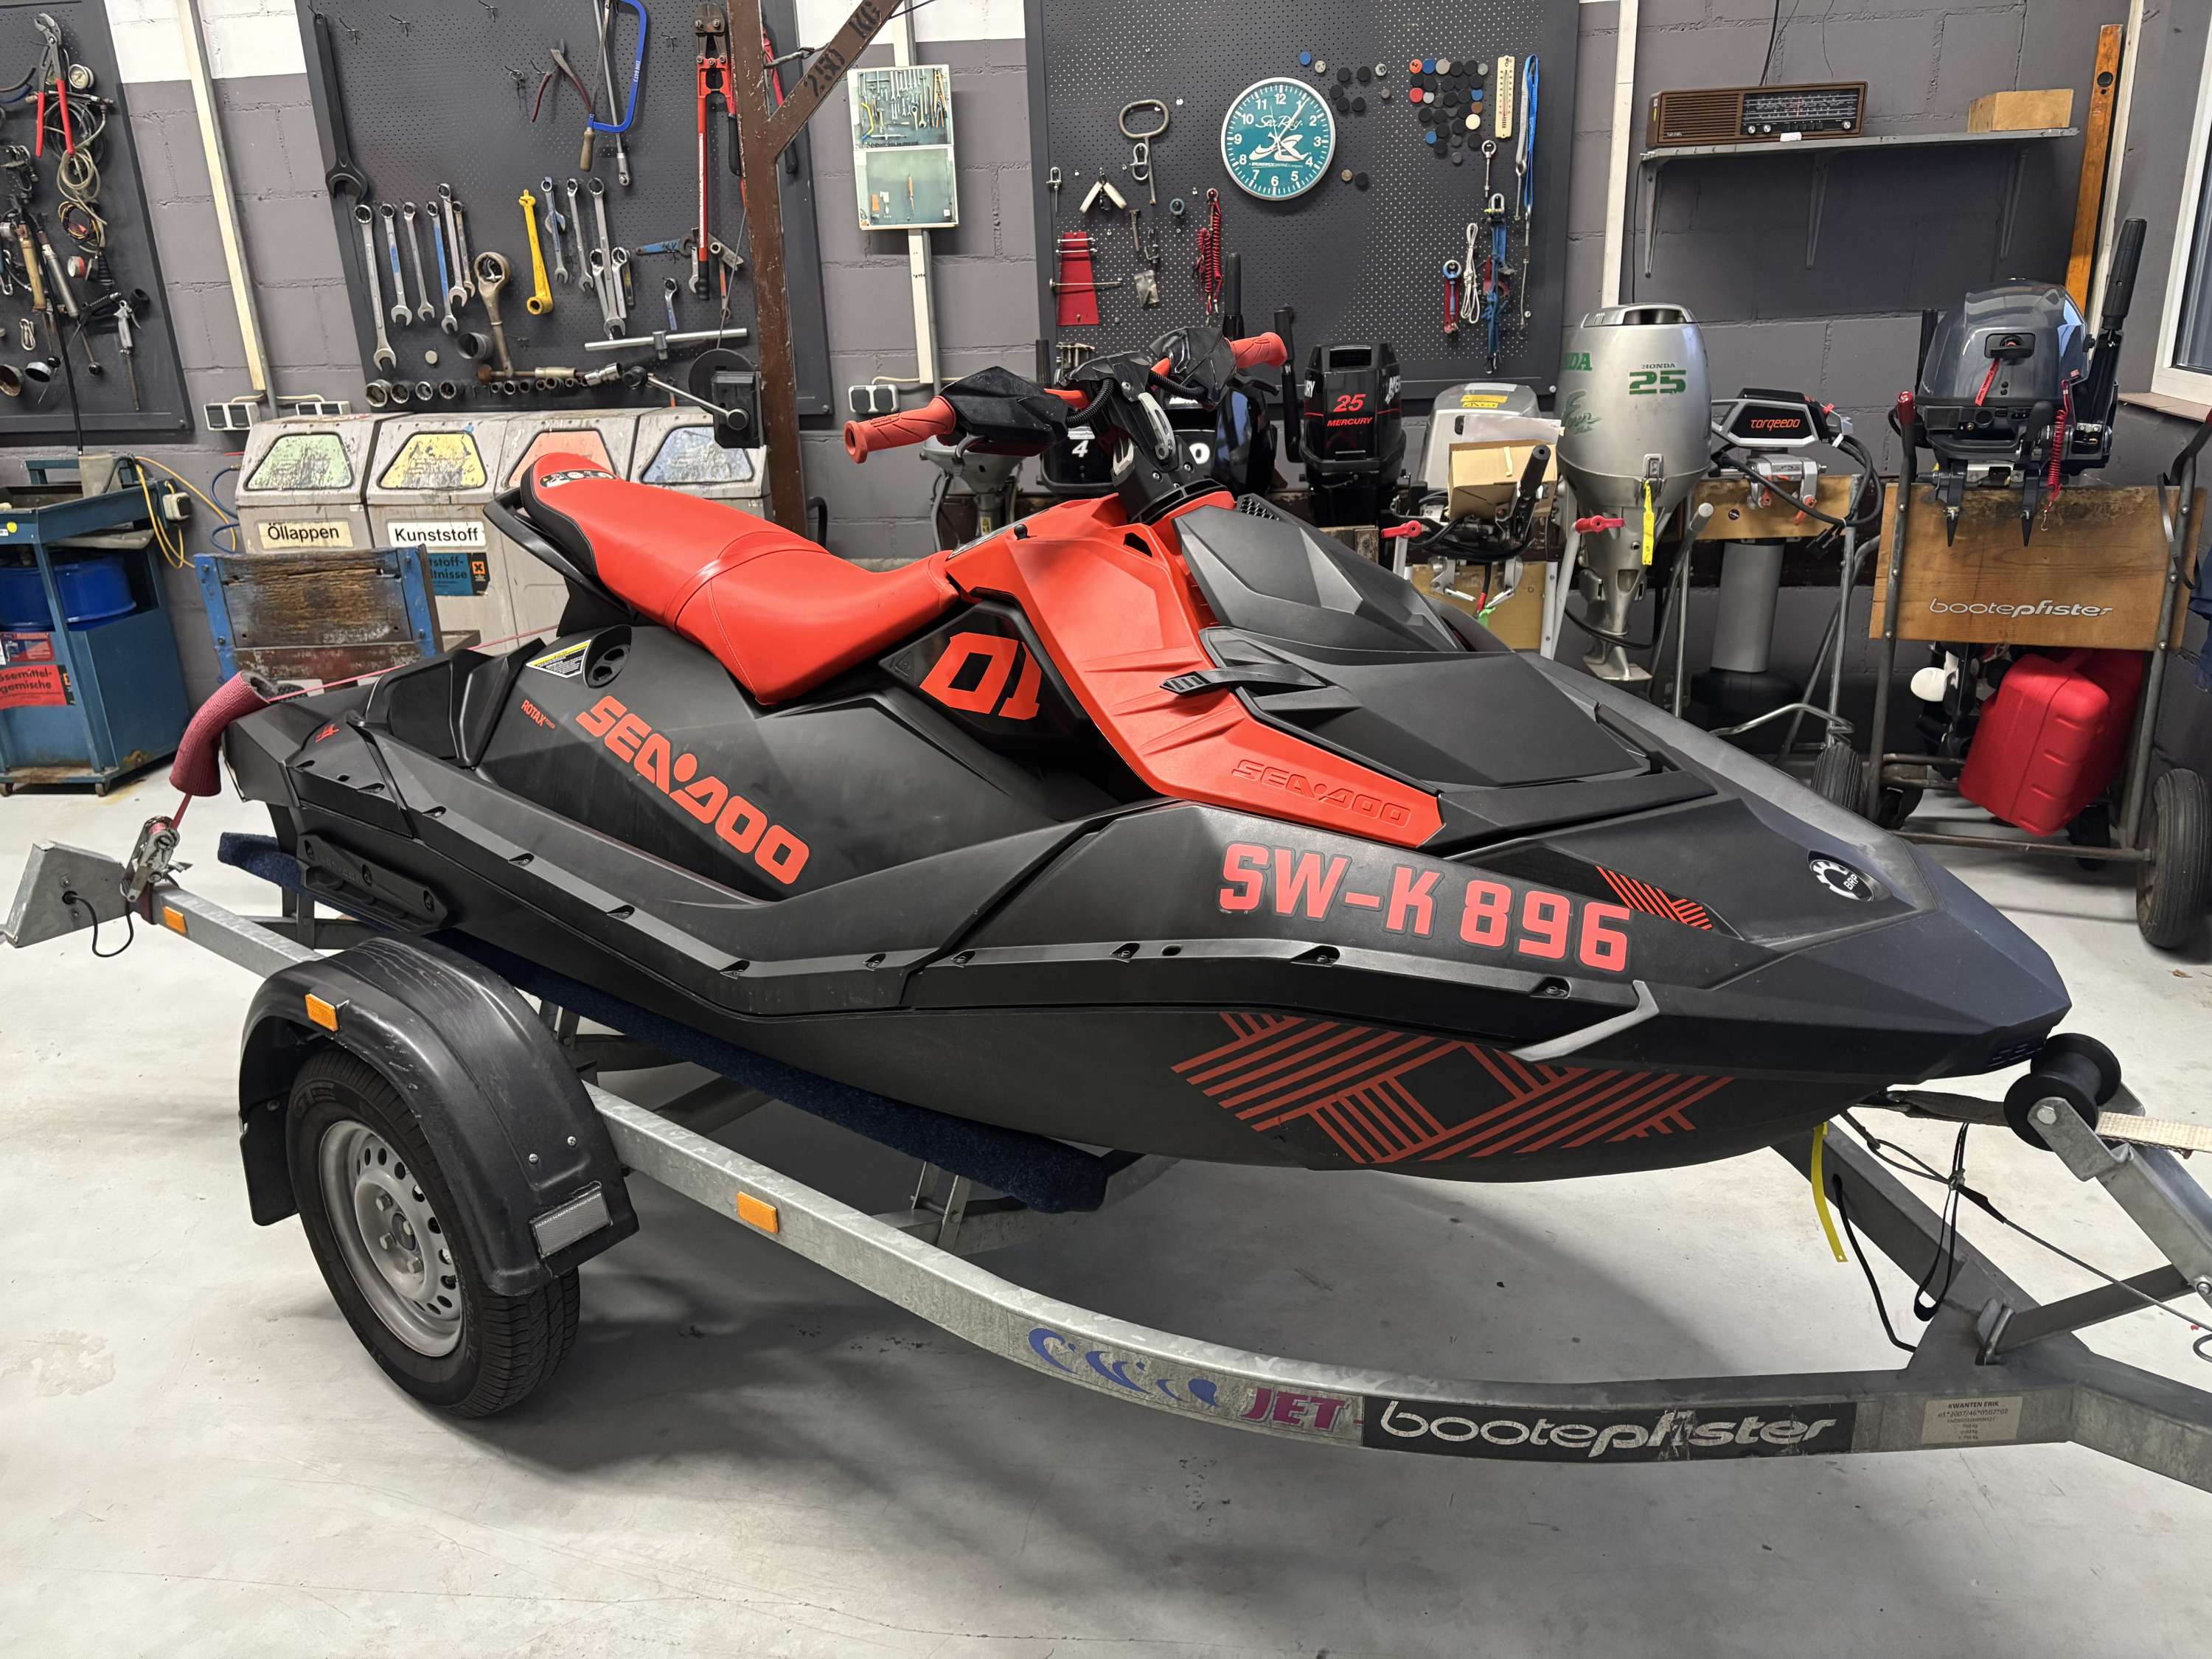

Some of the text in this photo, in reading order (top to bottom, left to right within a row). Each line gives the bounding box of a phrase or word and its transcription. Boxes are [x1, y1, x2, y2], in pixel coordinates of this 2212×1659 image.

[1256, 99, 1267, 111] 11
[1274, 93, 1287, 105] 12
[1242, 113, 1254, 125] 10
[1309, 115, 1318, 127] 2
[1234, 133, 1242, 145] 9
[1313, 136, 1322, 147] 3
[1239, 153, 1248, 165] 8
[1305, 156, 1314, 167] 4
[1252, 169, 1261, 180] 7
[1290, 170, 1299, 181] 5
[1270, 175, 1279, 187] 6
[1629, 369, 1686, 395] 25
[1332, 394, 1367, 413] 25
[1326, 417, 1374, 427] MERCURY
[1071, 439, 1089, 458] 4
[267, 522, 340, 542] Öllappen
[394, 526, 479, 542] Kunststoff
[1929, 598, 2113, 619] bootepfister
[521, 699, 546, 728] ROTAX
[1843, 874, 1859, 891] BRP
[1219, 843, 1631, 973] SW-K 896
[1240, 1387, 1346, 1430] JET
